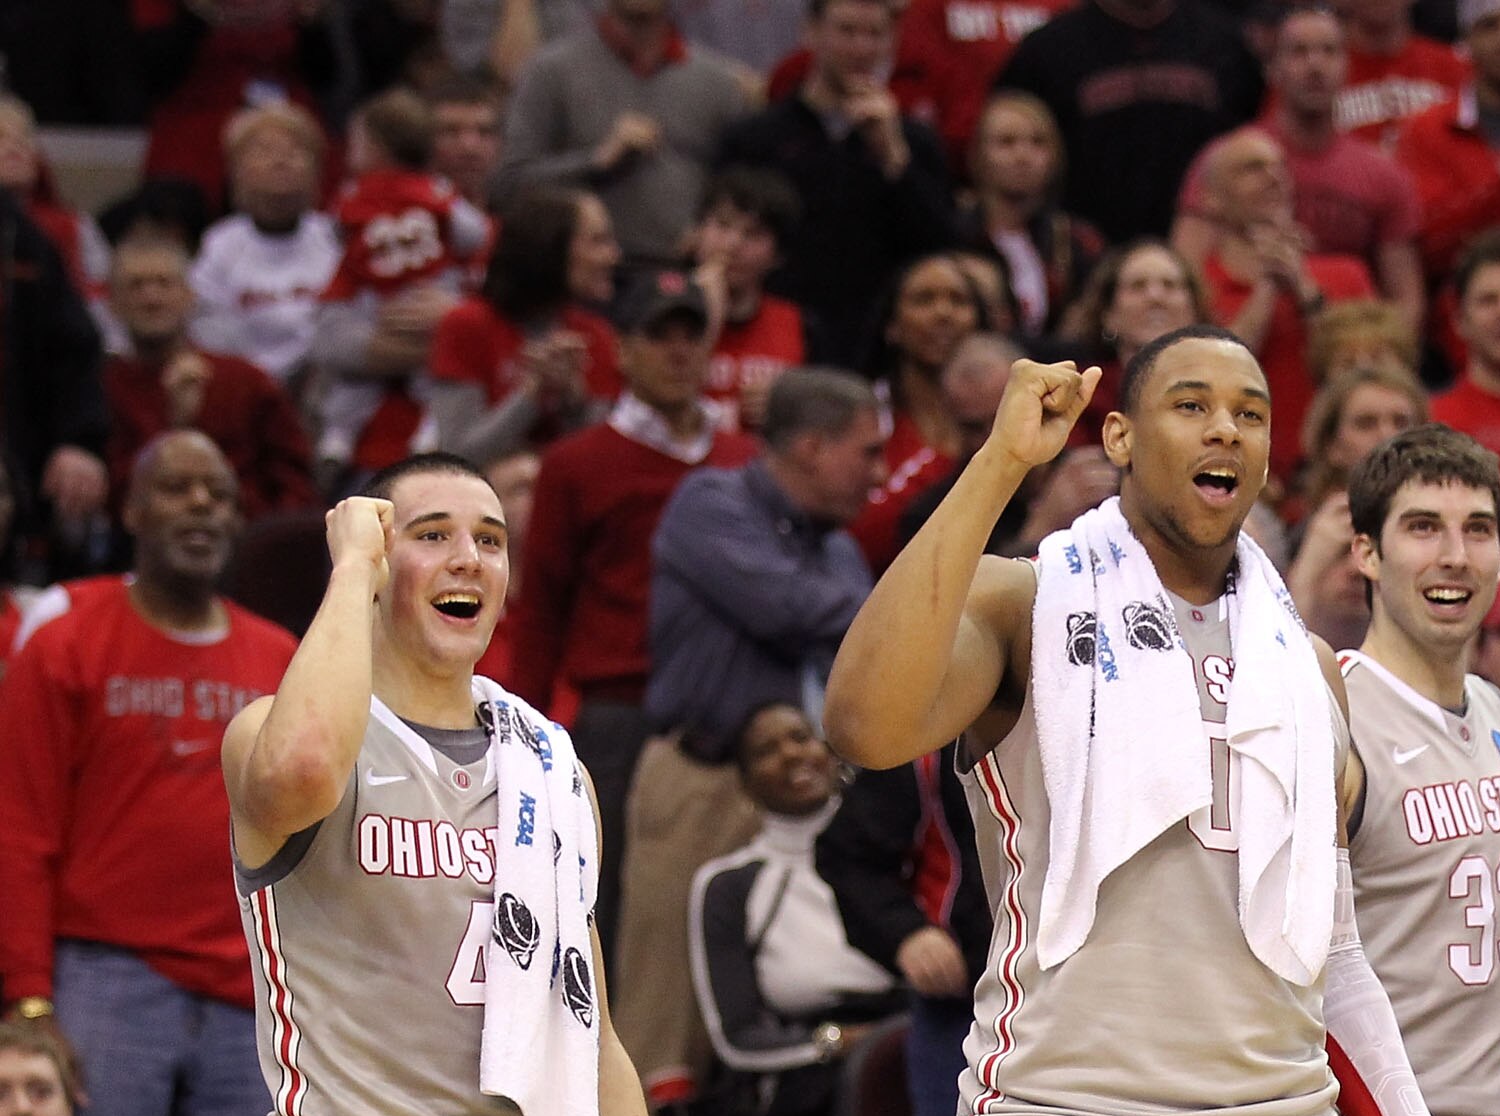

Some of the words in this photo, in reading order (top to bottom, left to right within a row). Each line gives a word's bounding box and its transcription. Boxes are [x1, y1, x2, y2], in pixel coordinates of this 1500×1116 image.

[514, 789, 537, 848] NCAA
[1402, 780, 1483, 845] OHIO
[358, 813, 464, 879] OHIO
